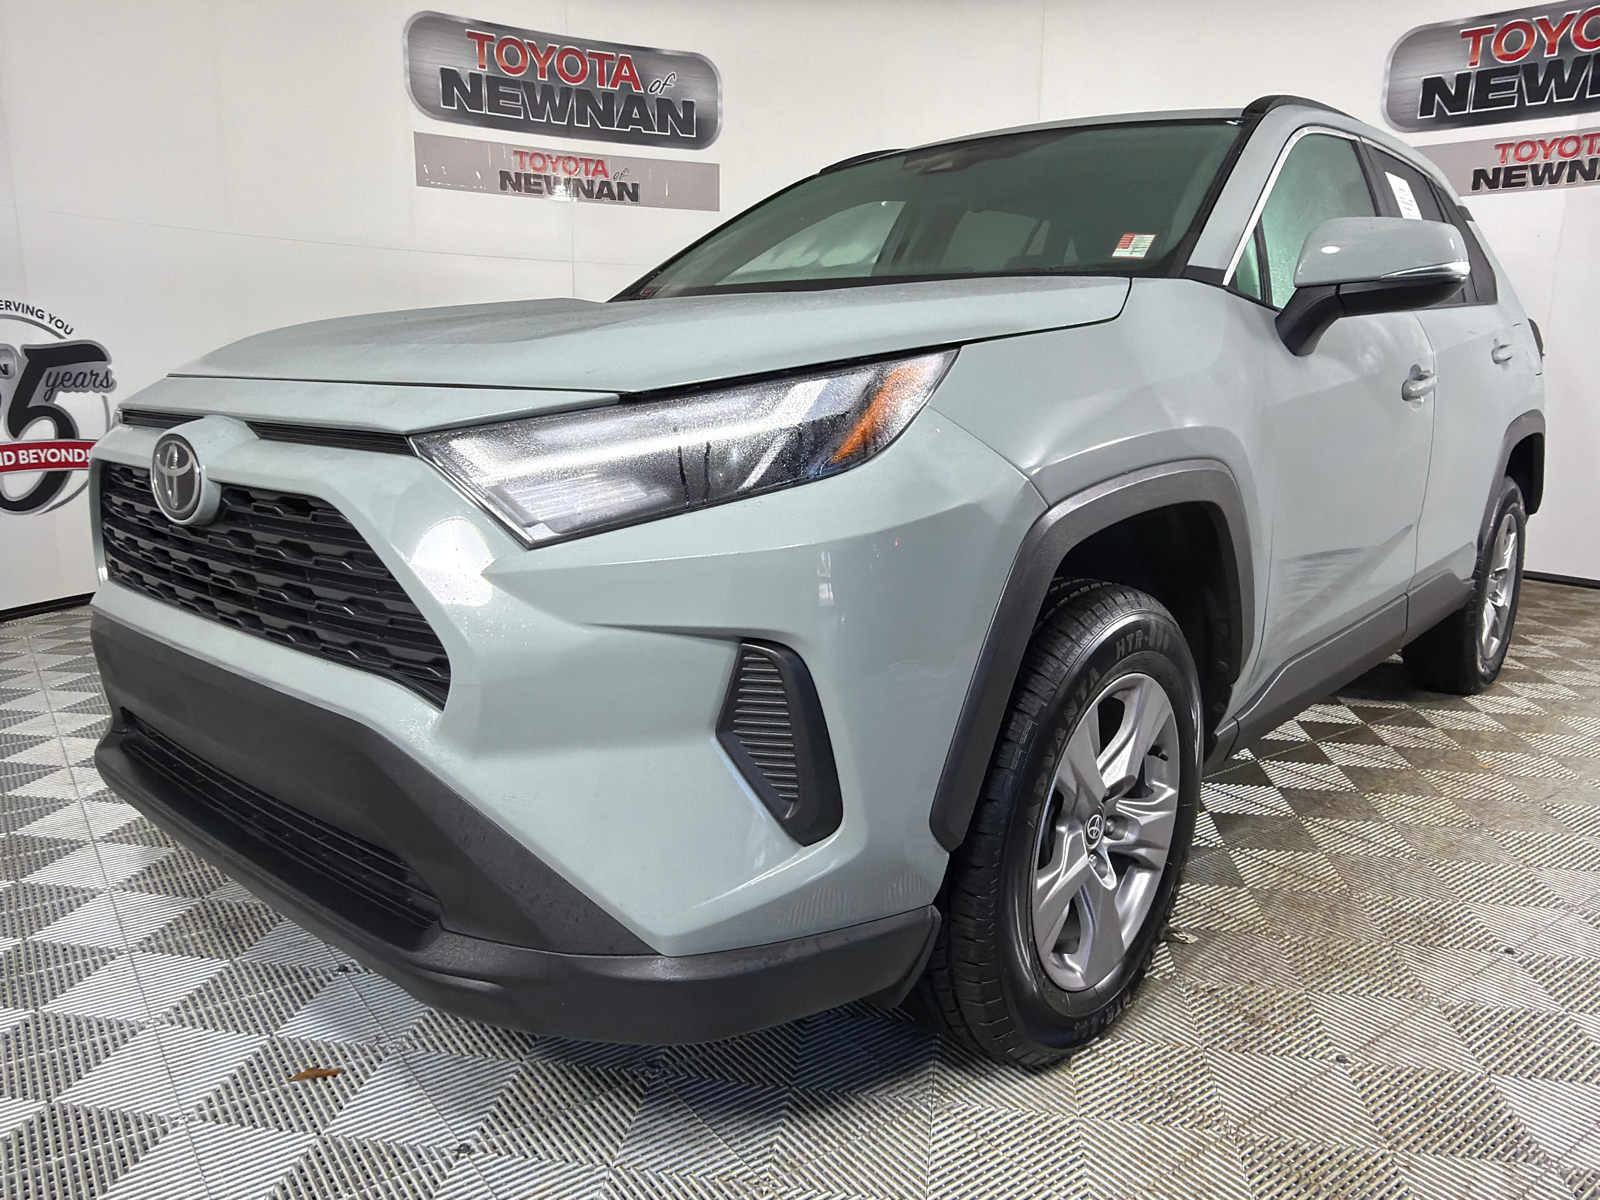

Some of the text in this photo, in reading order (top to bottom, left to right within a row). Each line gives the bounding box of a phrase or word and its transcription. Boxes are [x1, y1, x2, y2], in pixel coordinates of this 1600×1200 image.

[466, 29, 676, 95] TOYOTA of
[440, 67, 696, 137] NEWNAN
[1495, 132, 1600, 164] TOYOT
[513, 150, 629, 180] TOYOTA of
[1471, 158, 1600, 191] NEWN
[499, 169, 640, 202] NEWNAN
[48, 313, 74, 335] YOU
[44, 368, 114, 402] years
